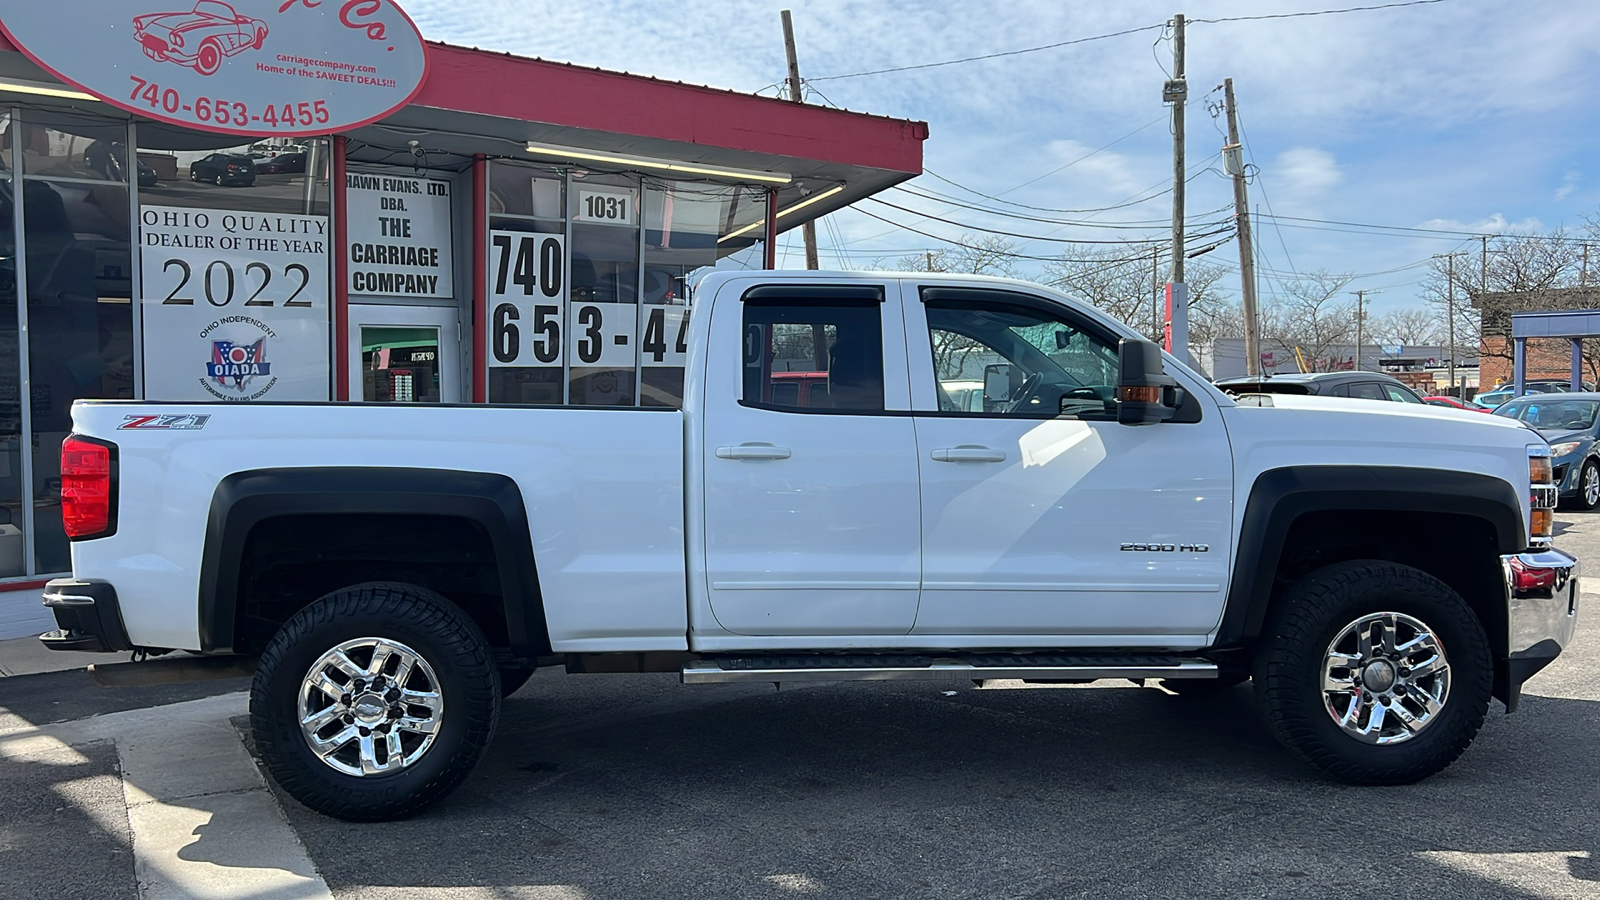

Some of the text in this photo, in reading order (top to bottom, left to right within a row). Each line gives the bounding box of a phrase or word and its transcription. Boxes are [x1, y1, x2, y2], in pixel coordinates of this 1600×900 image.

[338, 0, 394, 51] Co.
[256, 62, 396, 88] Home of the SAWEET DEALS!!!
[276, 54, 377, 73] carriagecompany.com
[129, 75, 330, 128] 740-653-4455
[383, 178, 423, 195] EVANS.
[427, 182, 449, 197] LTD.
[380, 197, 408, 212] DBA.
[585, 195, 626, 220] 1031
[143, 210, 327, 235] OHIO QUALITY
[378, 216, 412, 238] THE
[146, 232, 324, 254] DEALER OF THE YEAR
[351, 242, 439, 268] CARRIAGE
[493, 235, 562, 298] 740
[162, 258, 313, 308] 2022
[353, 271, 439, 294] COMPANY
[199, 315, 277, 339] OHIO INDEPENDENT
[214, 363, 260, 376] OIADA
[250, 376, 278, 400] ASSOCIATION
[116, 414, 211, 430] Z71
[1120, 542, 1209, 553] 2500 HD
